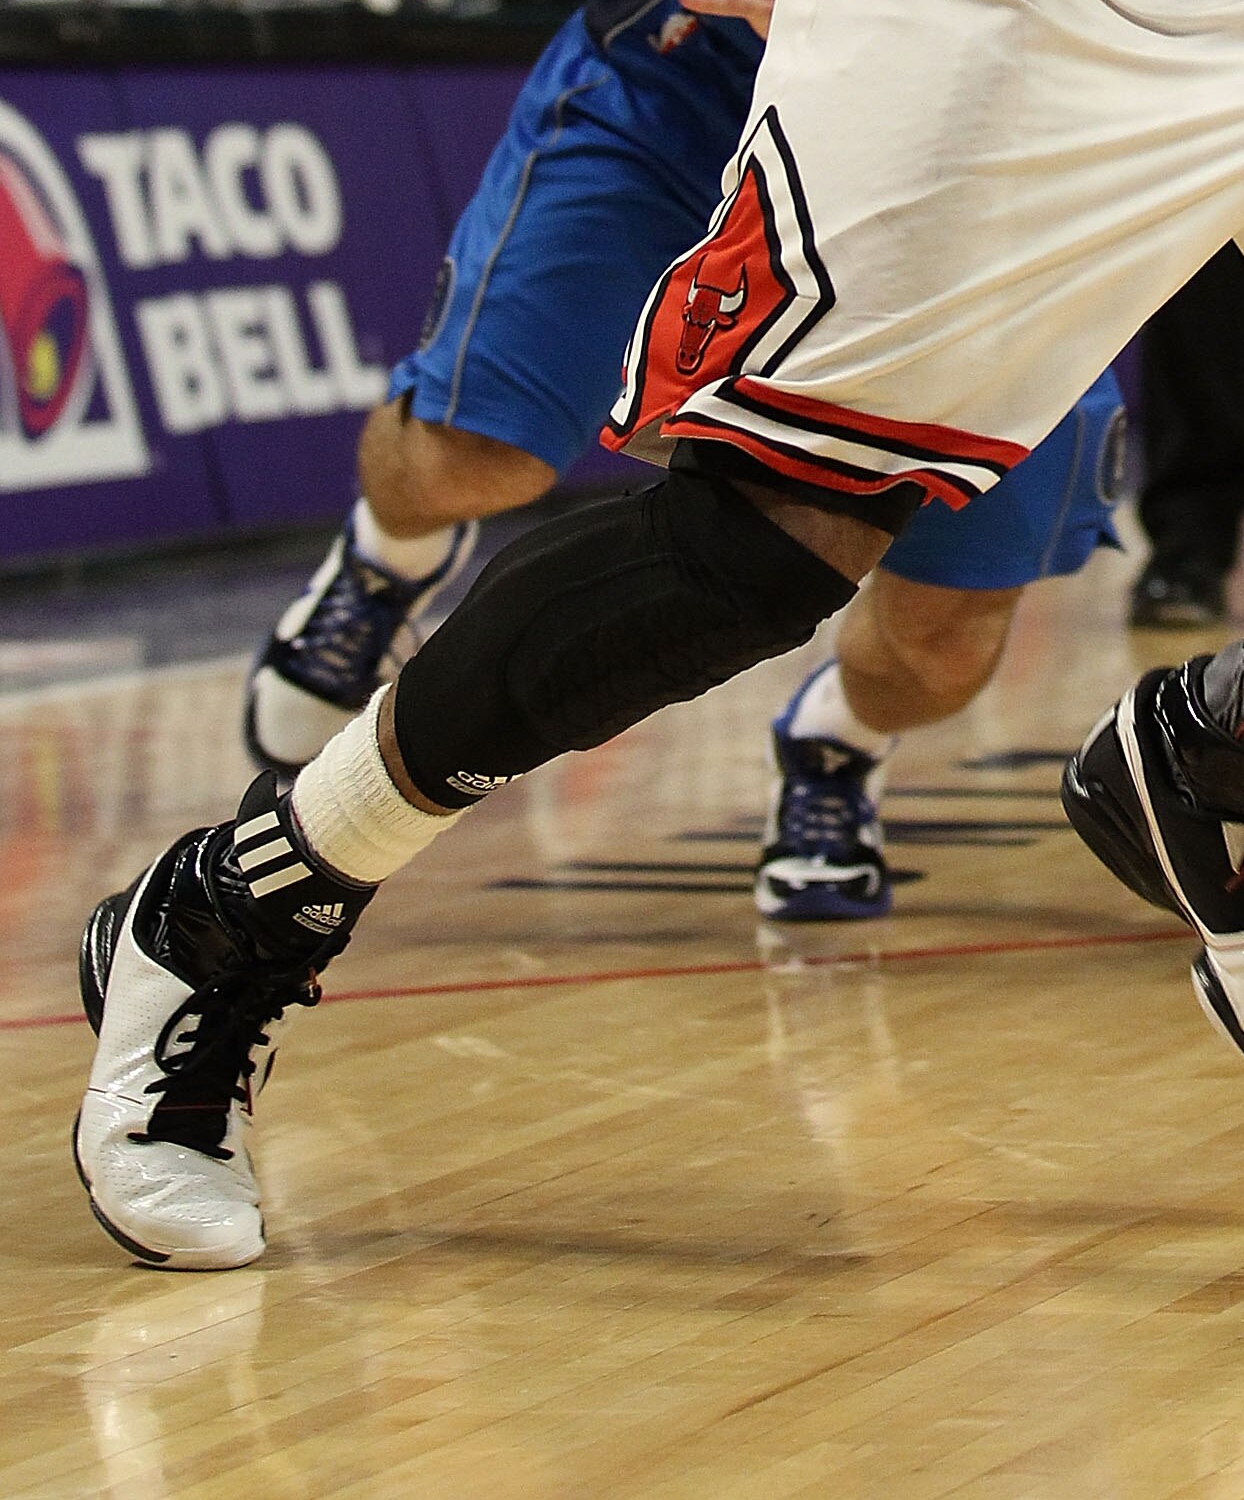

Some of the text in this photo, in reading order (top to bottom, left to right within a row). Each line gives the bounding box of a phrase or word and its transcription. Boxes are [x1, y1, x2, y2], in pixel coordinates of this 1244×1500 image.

[76, 121, 345, 271] TACO
[136, 279, 391, 436] BELL
[301, 905, 343, 927] adidas
